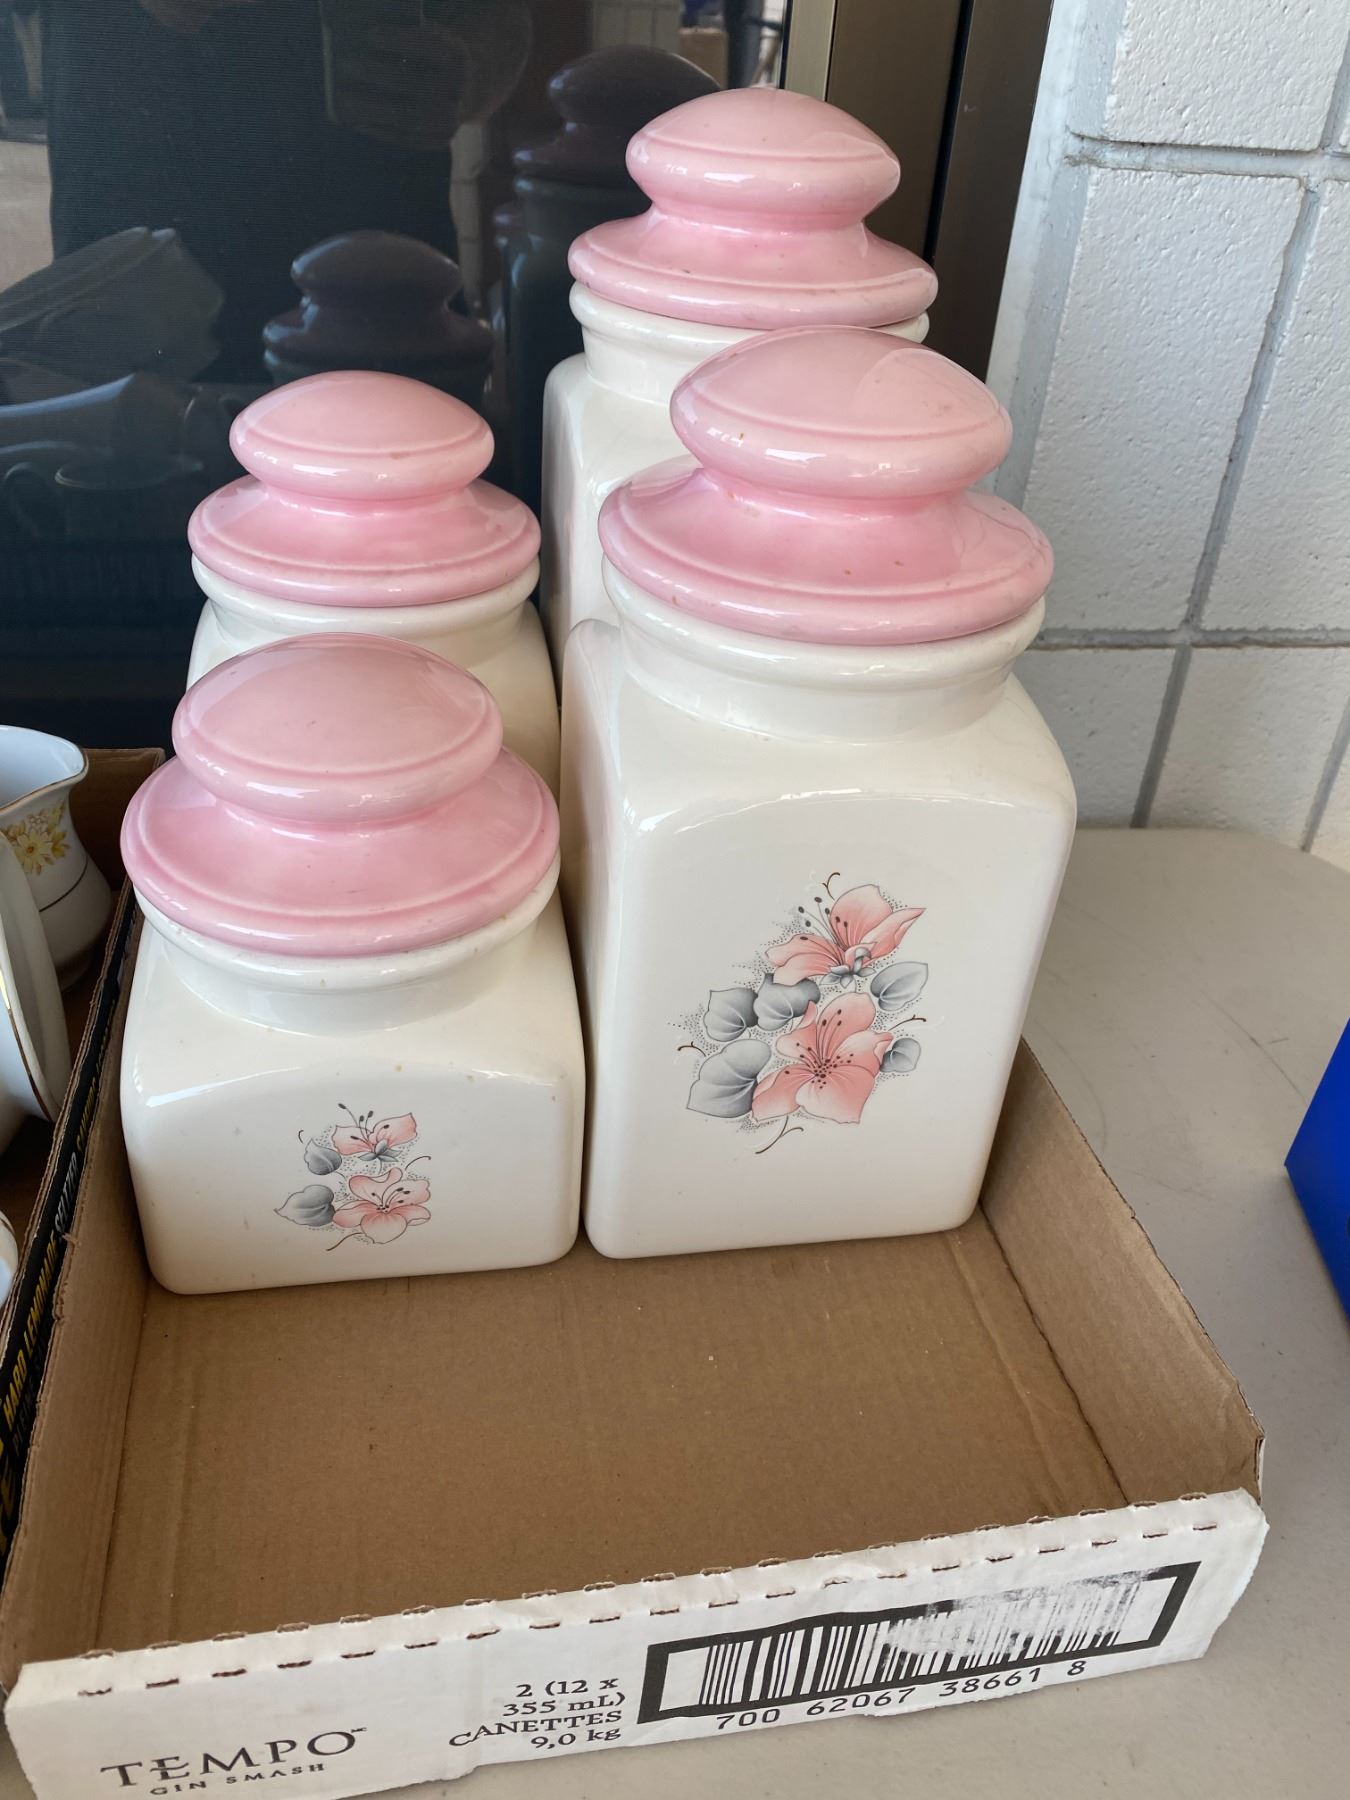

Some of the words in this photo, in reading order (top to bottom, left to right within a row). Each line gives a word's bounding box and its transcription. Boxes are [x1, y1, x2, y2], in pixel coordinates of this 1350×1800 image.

[3, 1348, 27, 1432] HARD
[503, 1700, 557, 1717] 355
[567, 1692, 626, 1712] mL)
[516, 1684, 533, 1698] 2
[545, 1679, 589, 1696] (12
[599, 1678, 619, 1690] x
[716, 1708, 781, 1730] 700
[806, 1687, 916, 1716] 62067
[939, 1667, 1042, 1698] 38661
[1066, 1660, 1086, 1676] 8
[449, 1710, 623, 1747] CANETTES
[531, 1733, 577, 1749] 9,0
[587, 1728, 622, 1742] kg
[100, 1731, 356, 1788] TEMPO
[150, 1781, 207, 1796] GIN
[226, 1763, 325, 1784] SMASH
